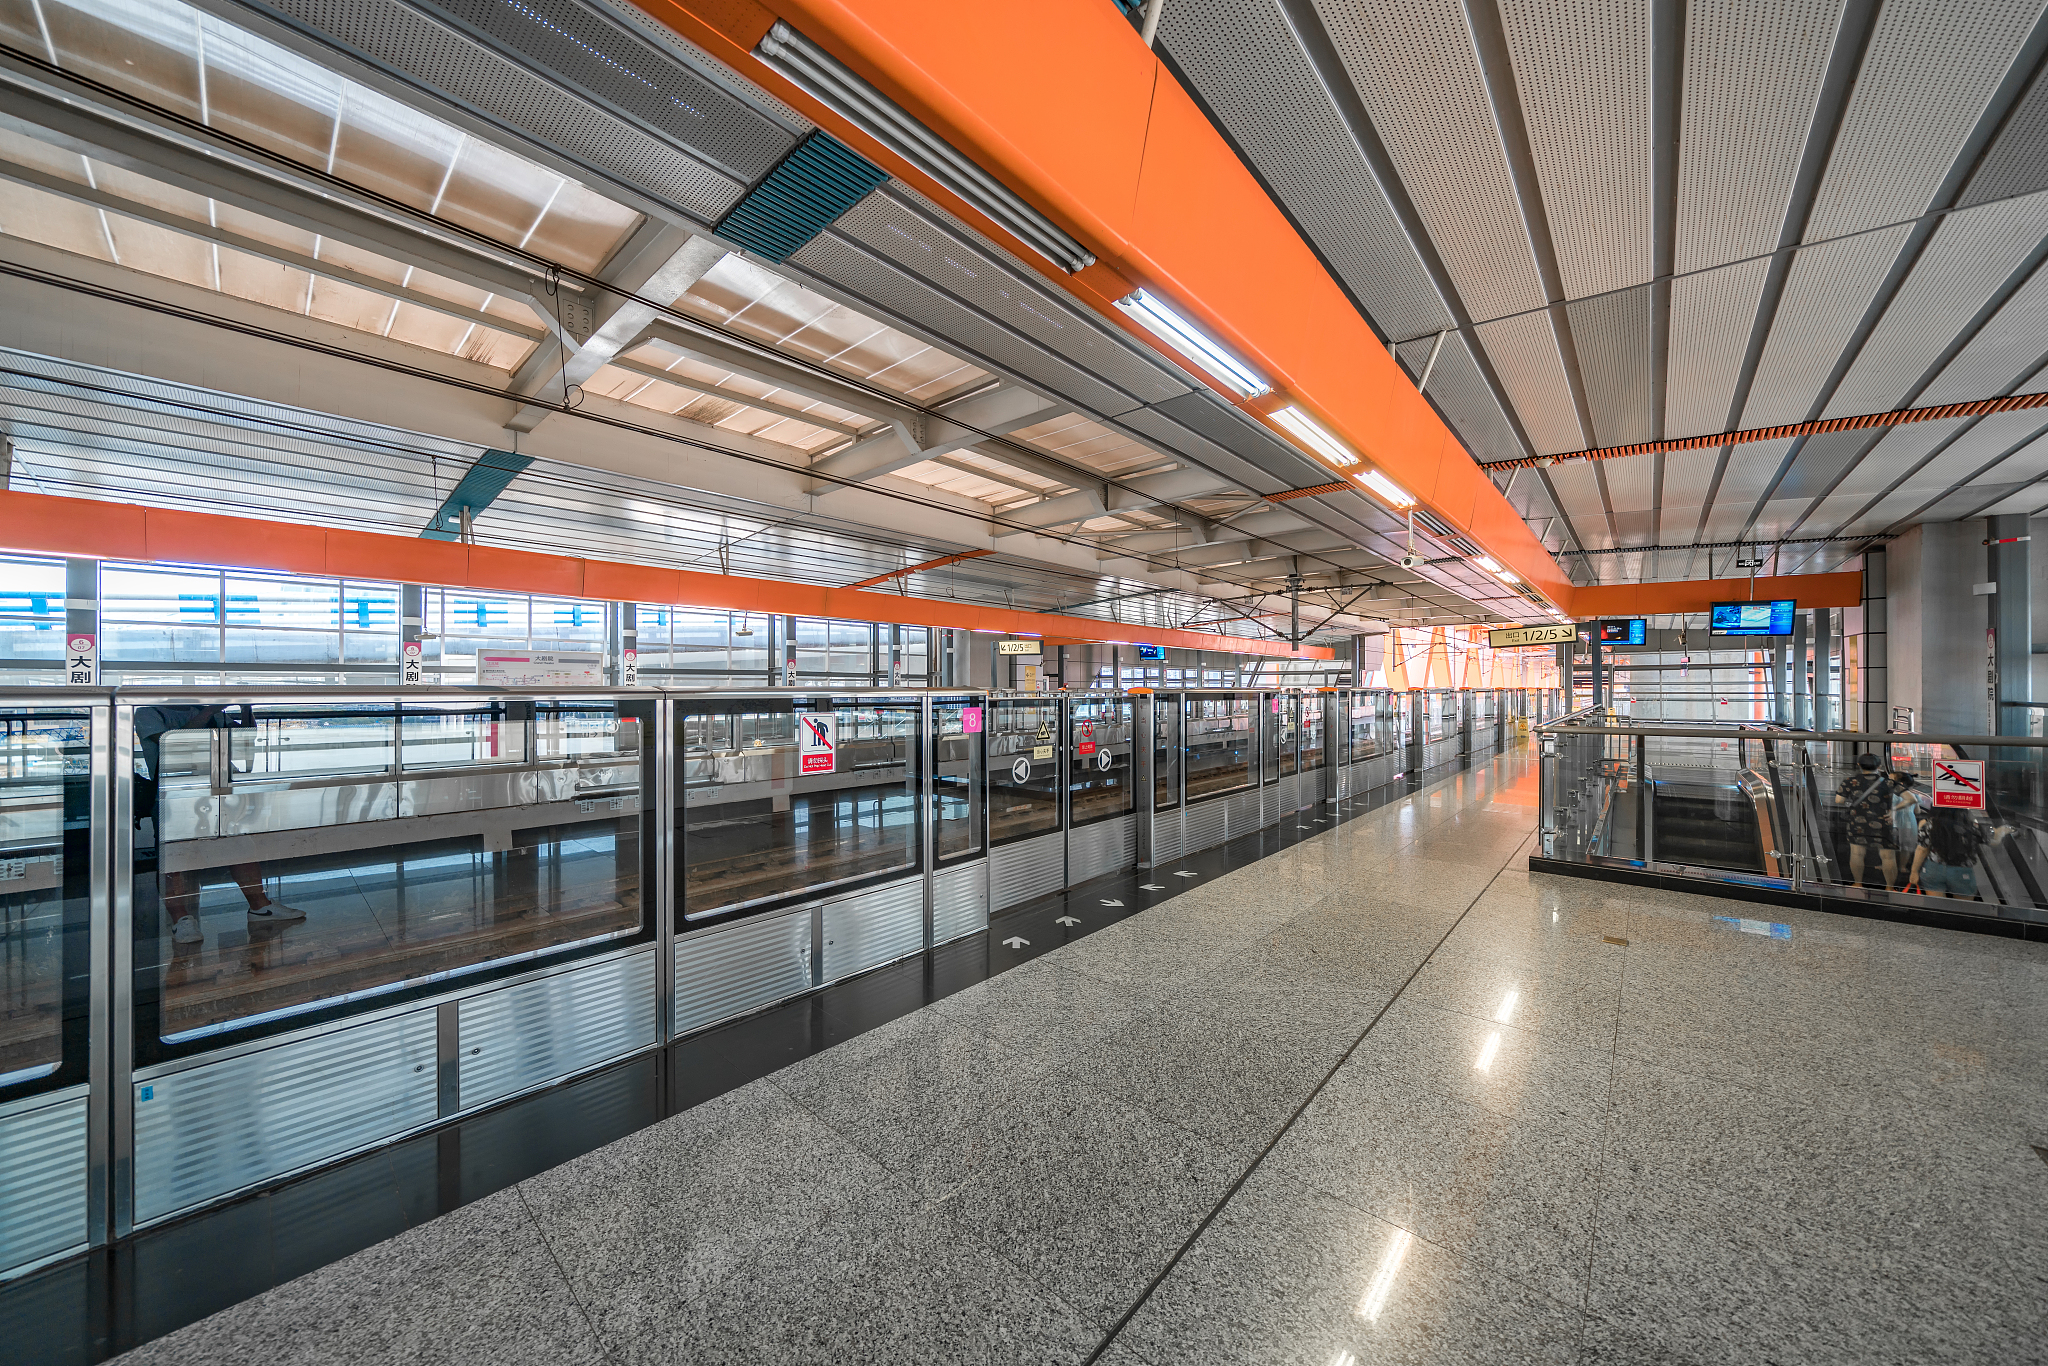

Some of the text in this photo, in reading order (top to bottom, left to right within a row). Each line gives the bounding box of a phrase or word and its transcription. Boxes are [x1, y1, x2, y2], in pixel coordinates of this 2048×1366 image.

[1522, 628, 1558, 642] 1/2/5
[1007, 643, 1024, 652] 1/2/5
[405, 659, 420, 685] 大剧
[969, 713, 976, 727] 8
